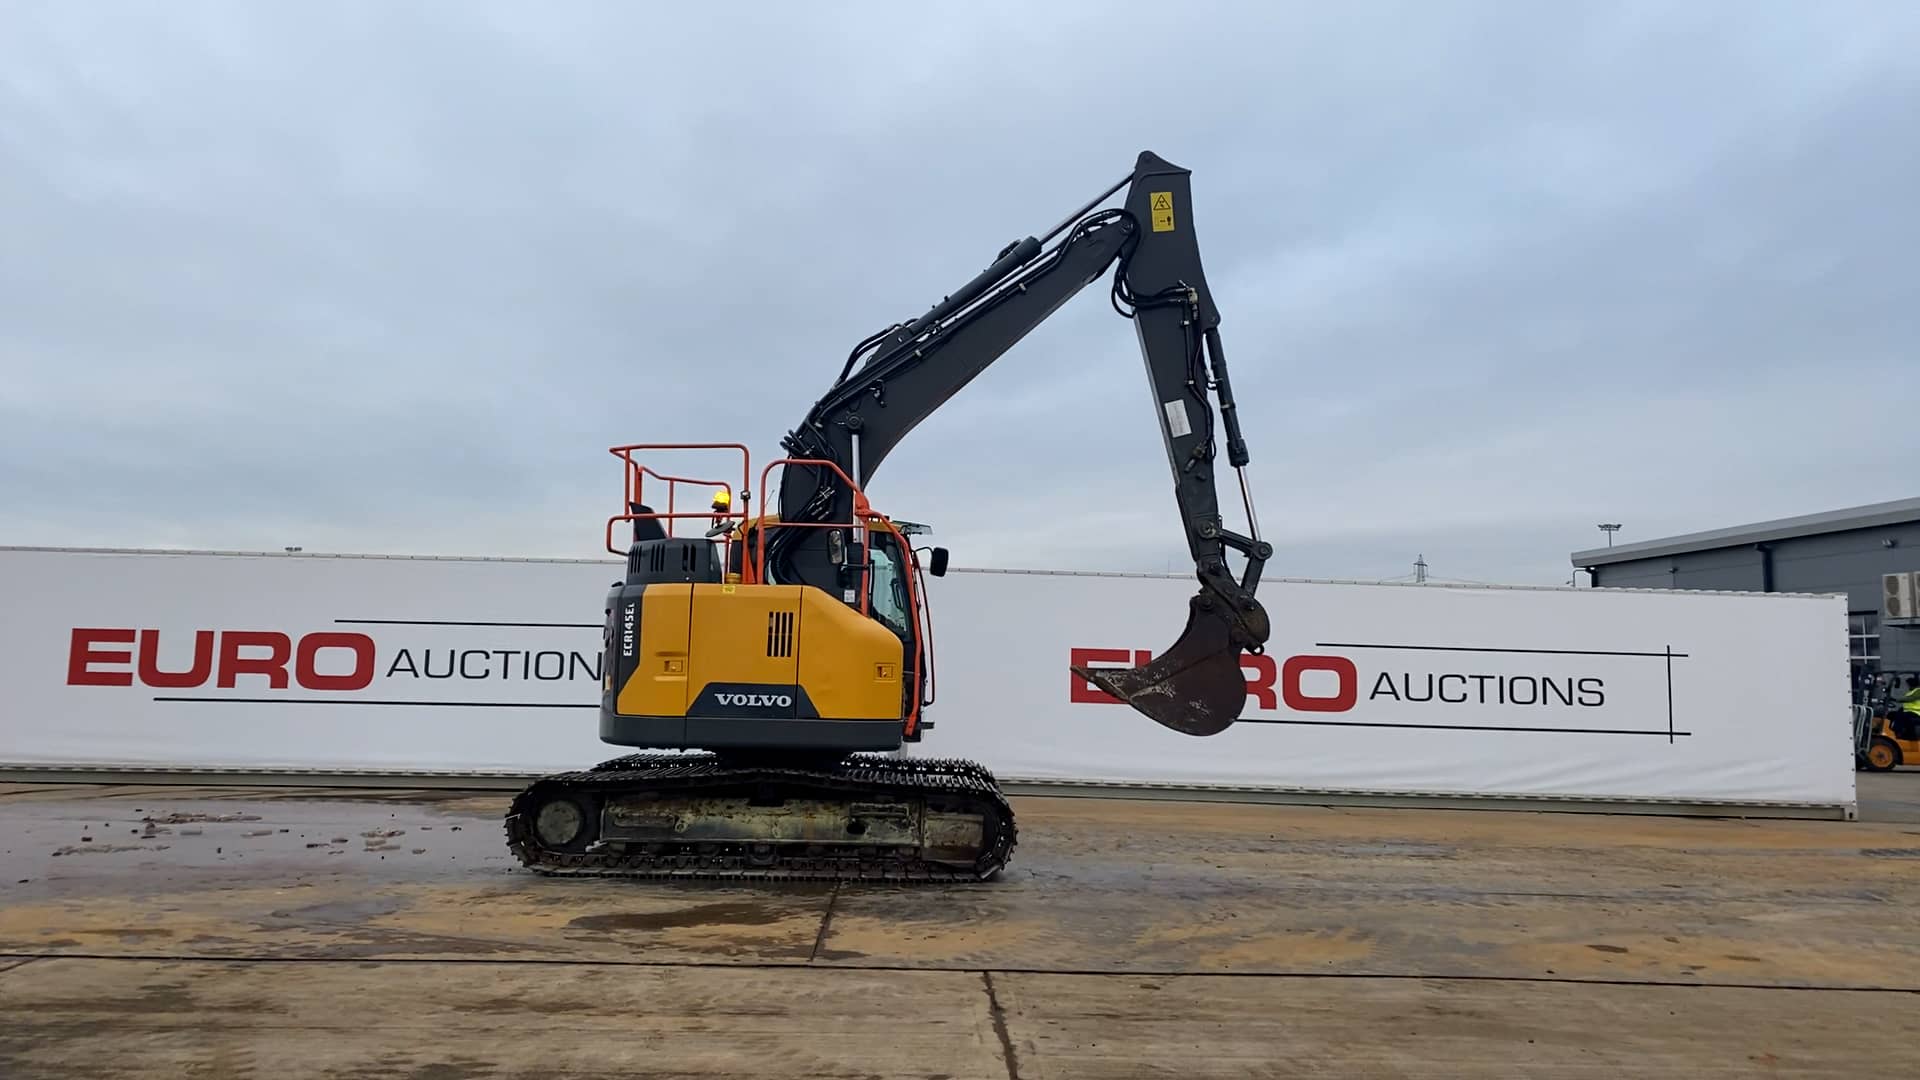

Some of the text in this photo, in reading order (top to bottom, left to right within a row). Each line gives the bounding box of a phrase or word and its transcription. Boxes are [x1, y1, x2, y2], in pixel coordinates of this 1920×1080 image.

[66, 627, 603, 691] EURO AUCTION
[1070, 647, 1606, 713] ERO AUCTIONS
[714, 693, 792, 707] VOLVO
